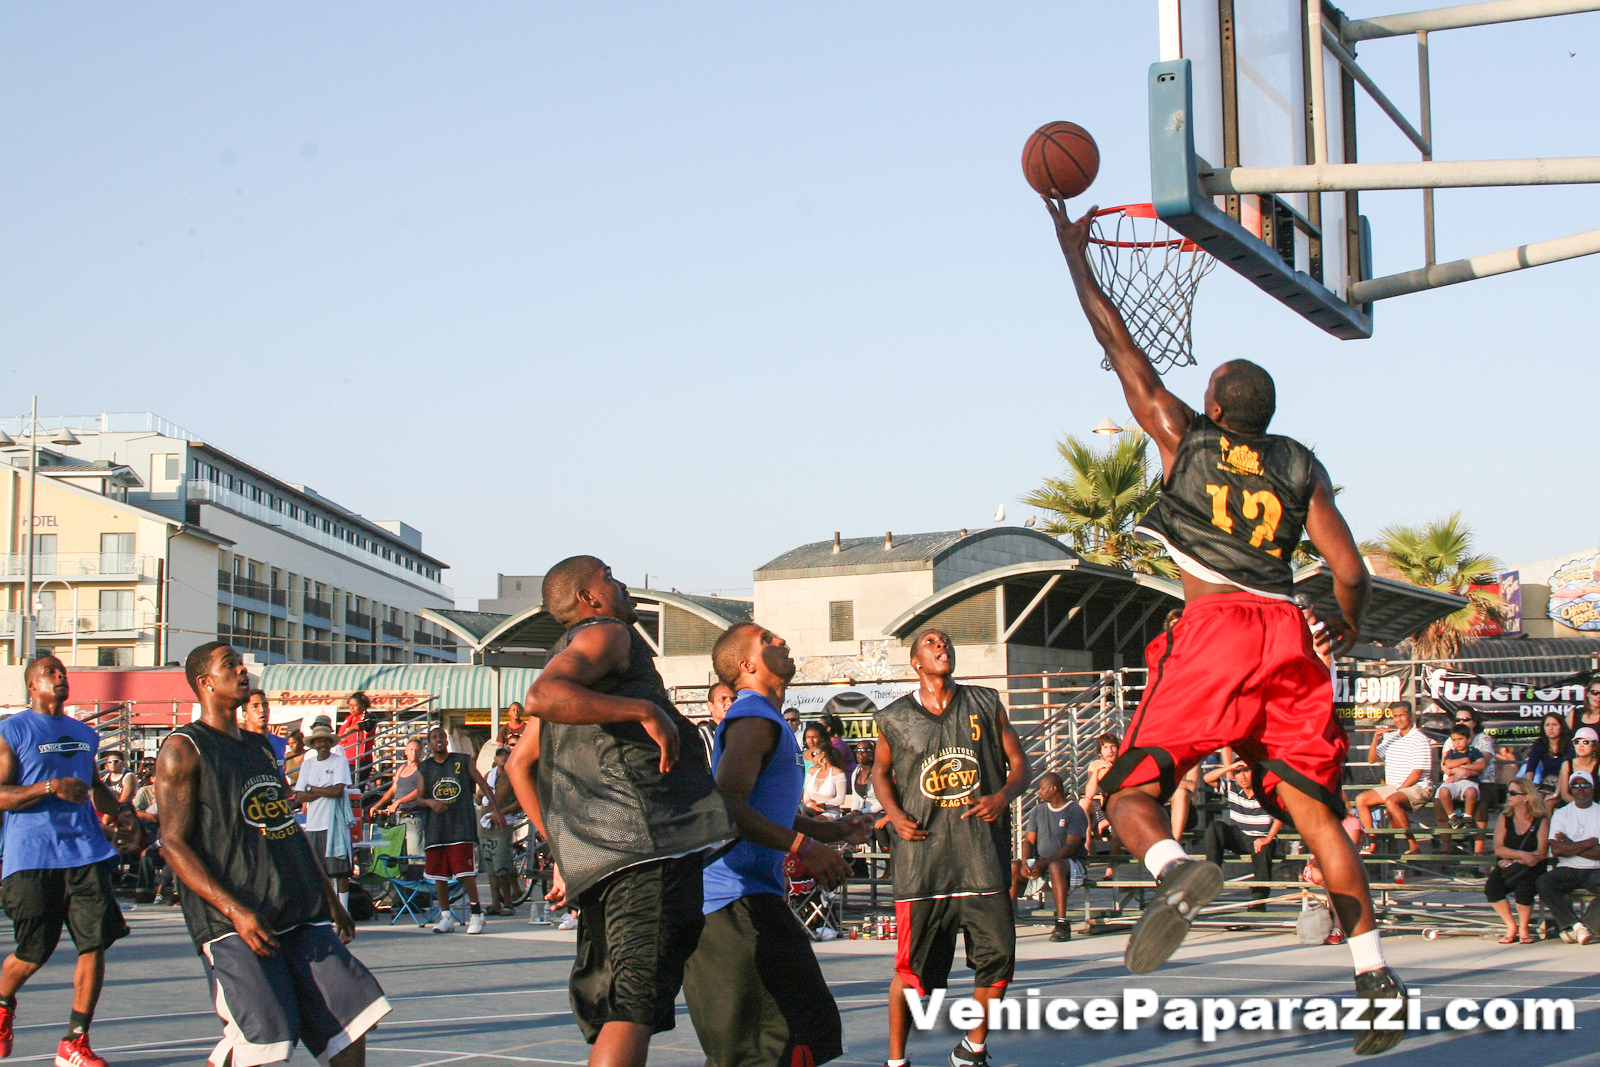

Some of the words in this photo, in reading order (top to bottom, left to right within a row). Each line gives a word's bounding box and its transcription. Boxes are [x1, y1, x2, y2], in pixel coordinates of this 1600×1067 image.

[22, 516, 59, 527] HOTEL
[1206, 484, 1283, 559] 12
[1430, 668, 1585, 702] function
[1336, 706, 1364, 718] made
[1366, 705, 1383, 718] the
[1519, 705, 1585, 718] DRINK
[969, 714, 982, 741] 5
[454, 761, 462, 774] 2
[925, 769, 978, 794] drew
[935, 797, 970, 808] EAGU
